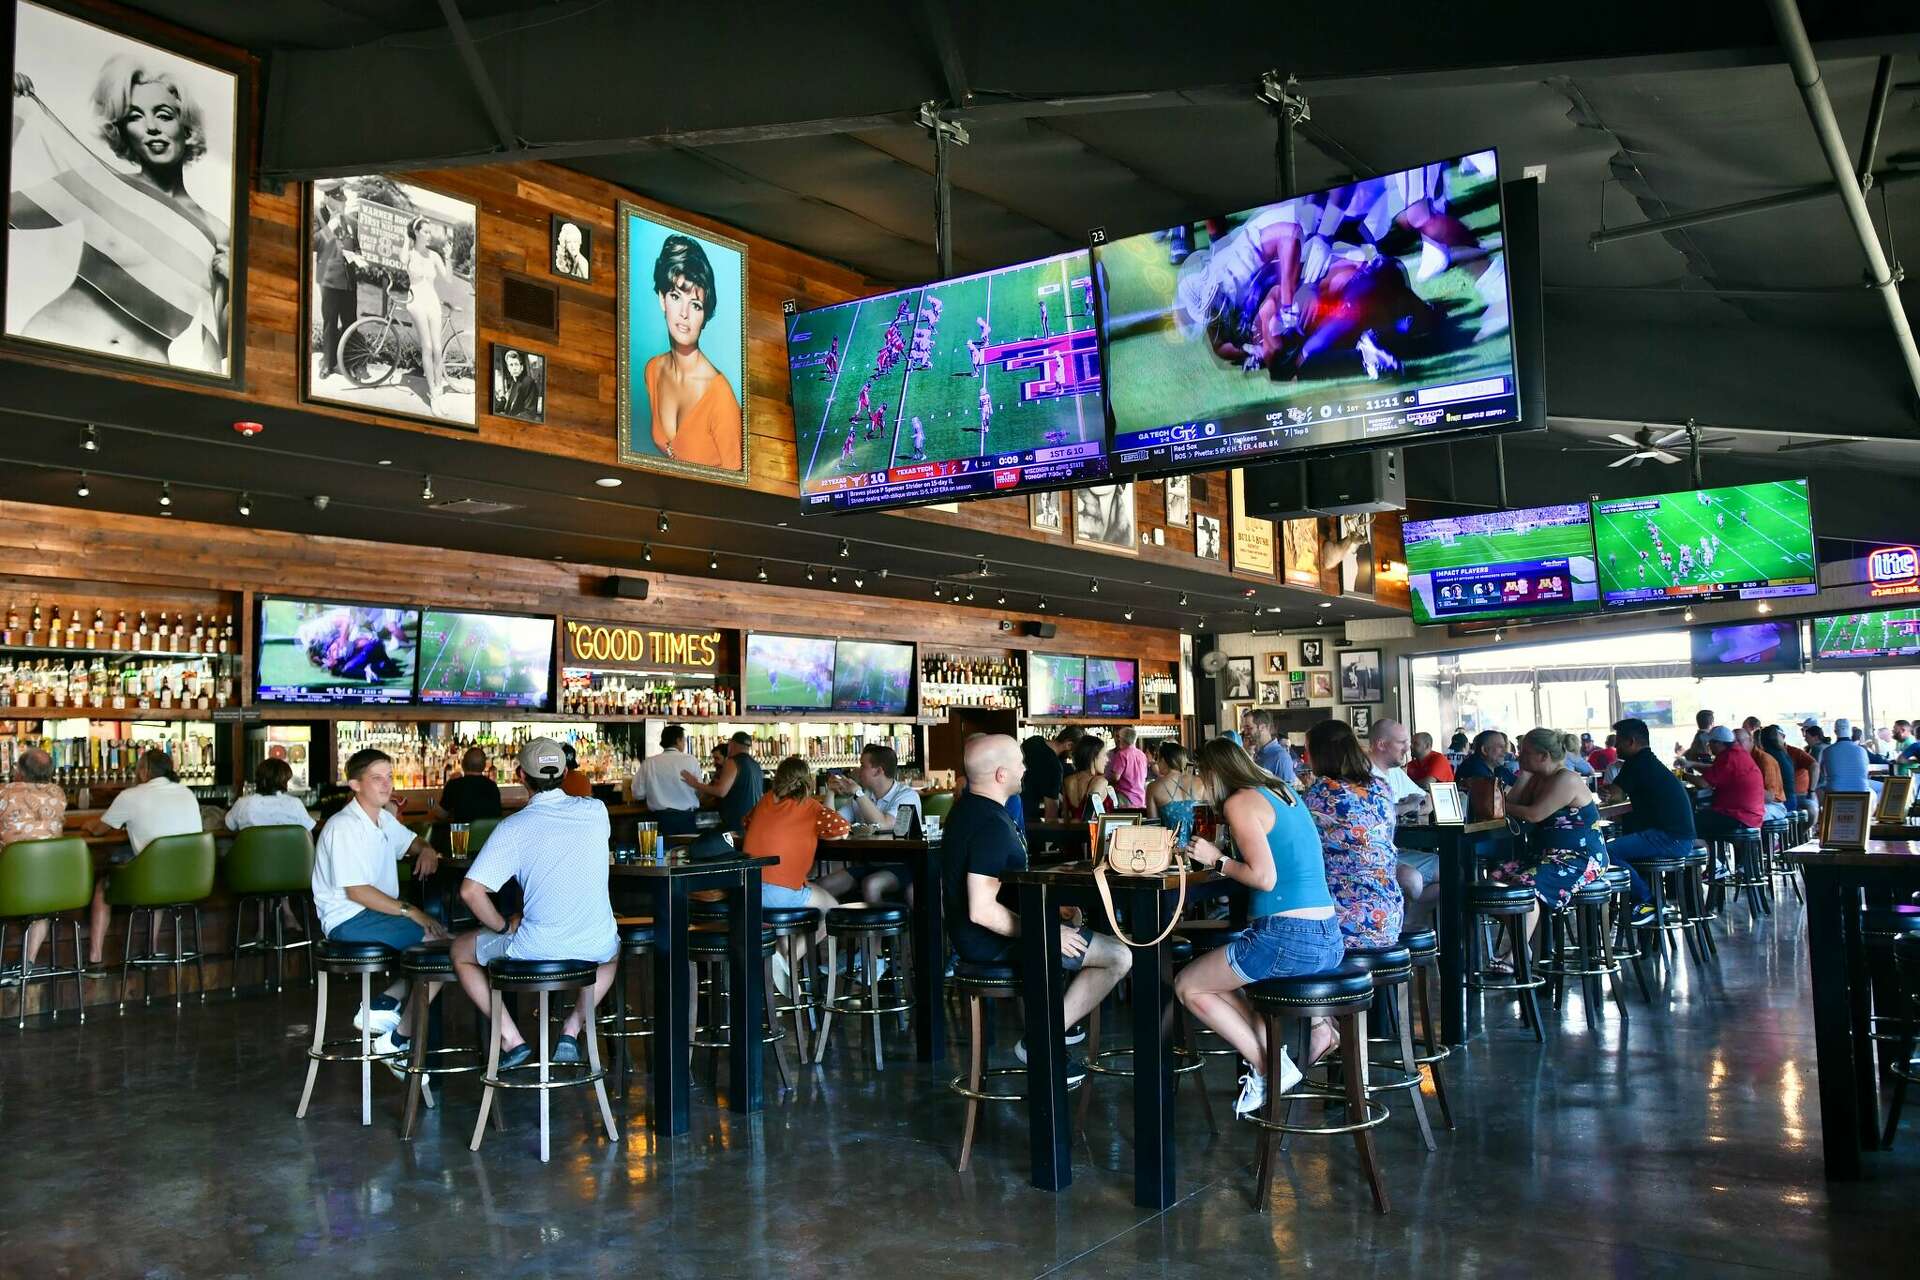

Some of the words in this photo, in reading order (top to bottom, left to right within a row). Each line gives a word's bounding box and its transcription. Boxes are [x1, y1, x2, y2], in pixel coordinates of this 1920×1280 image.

[1092, 230, 1105, 242] 23
[784, 303, 794, 313] 22
[1404, 396, 1415, 404] 40
[1266, 412, 1283, 421] UCF
[1320, 405, 1332, 418] 0
[1366, 397, 1400, 411] 11:11
[1149, 430, 1170, 438] TECH
[1204, 423, 1216, 435] 0
[1284, 429, 1289, 437] 7
[1050, 449, 1066, 458] 1ST
[1066, 448, 1074, 456] &
[1074, 447, 1084, 455] 10
[1173, 443, 1186, 452] Red
[1174, 452, 1187, 460] BOS
[896, 467, 917, 476] TEXAS
[917, 465, 934, 473] TECH
[962, 460, 970, 472] 7
[998, 455, 1019, 465] 0:09
[1024, 466, 1049, 475] WISCONSIN
[828, 477, 847, 486] TEXAS
[870, 473, 886, 485] 10
[1024, 472, 1047, 480] TONIGHT
[866, 488, 880, 496] place
[1874, 552, 1914, 580] Lite
[1436, 568, 1459, 577] IMPACT
[1460, 566, 1489, 575] PLAYERS
[1652, 589, 1664, 597] 10
